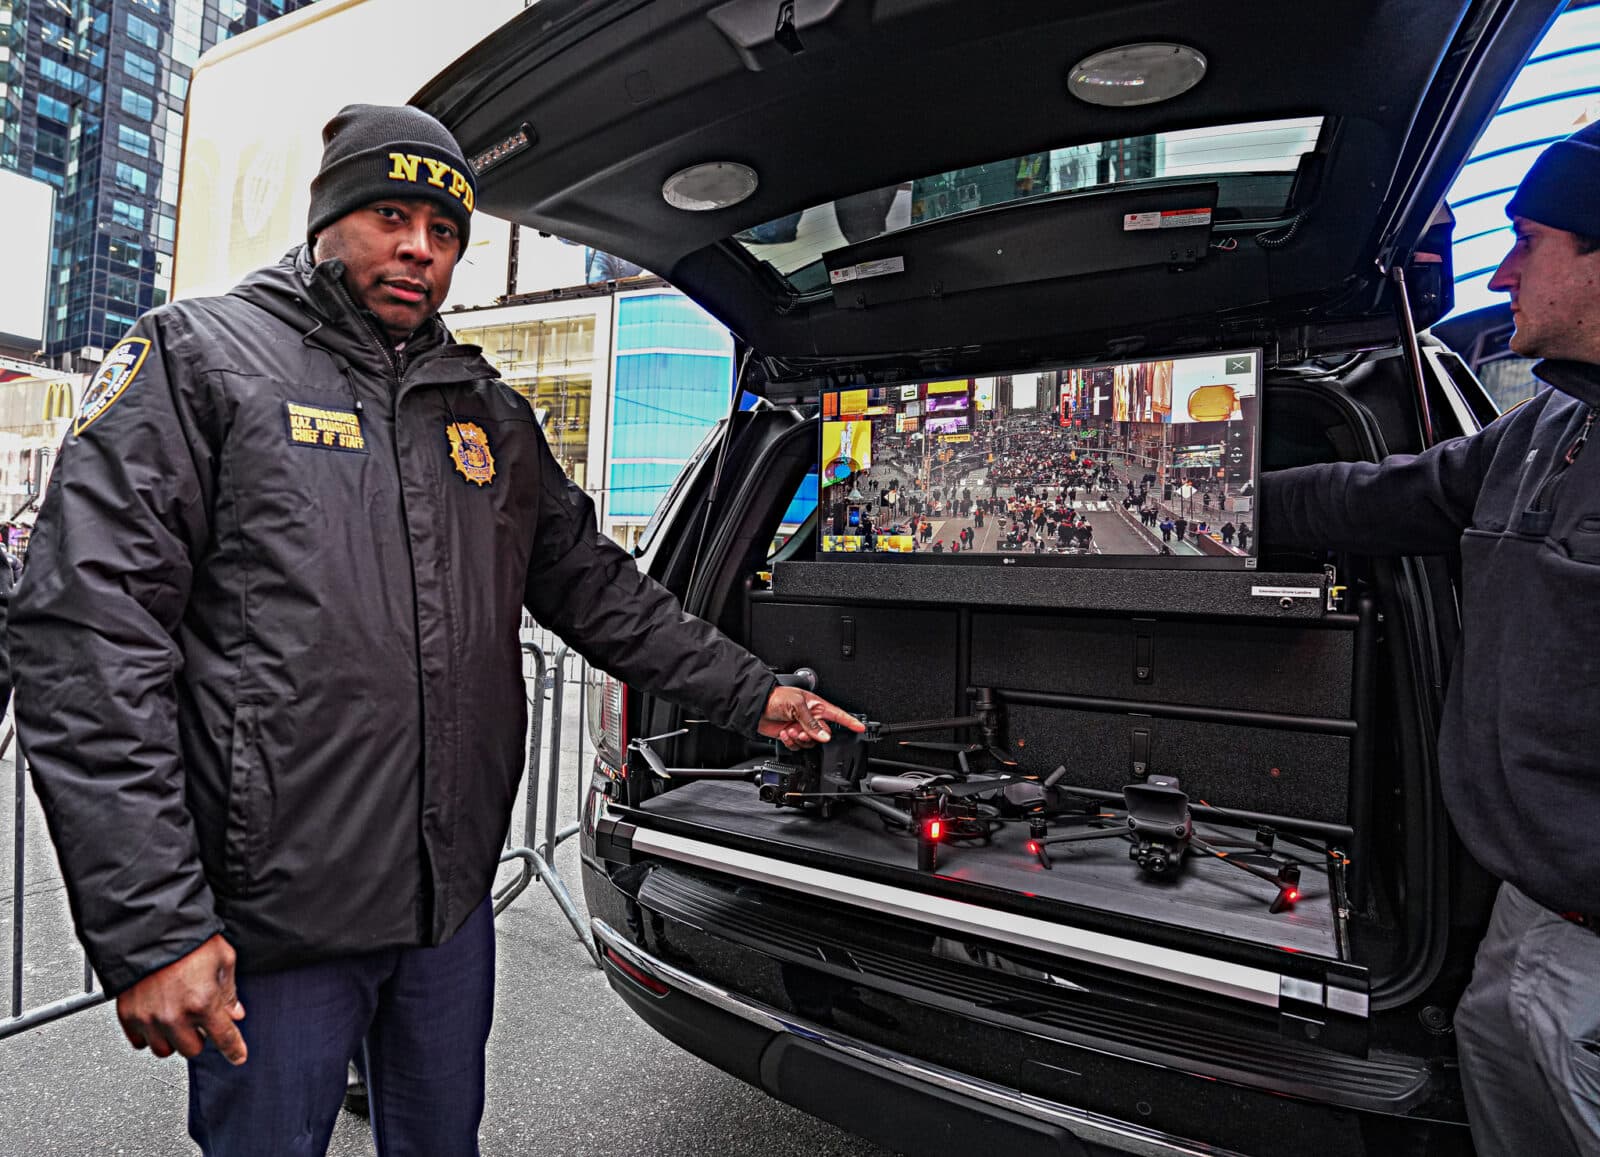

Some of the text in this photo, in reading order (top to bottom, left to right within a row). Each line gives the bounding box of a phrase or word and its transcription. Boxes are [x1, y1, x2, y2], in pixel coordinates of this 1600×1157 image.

[388, 153, 475, 213] NYPD
[290, 415, 313, 431] KAZ
[292, 428, 365, 449] CHIEF OF STAFF
